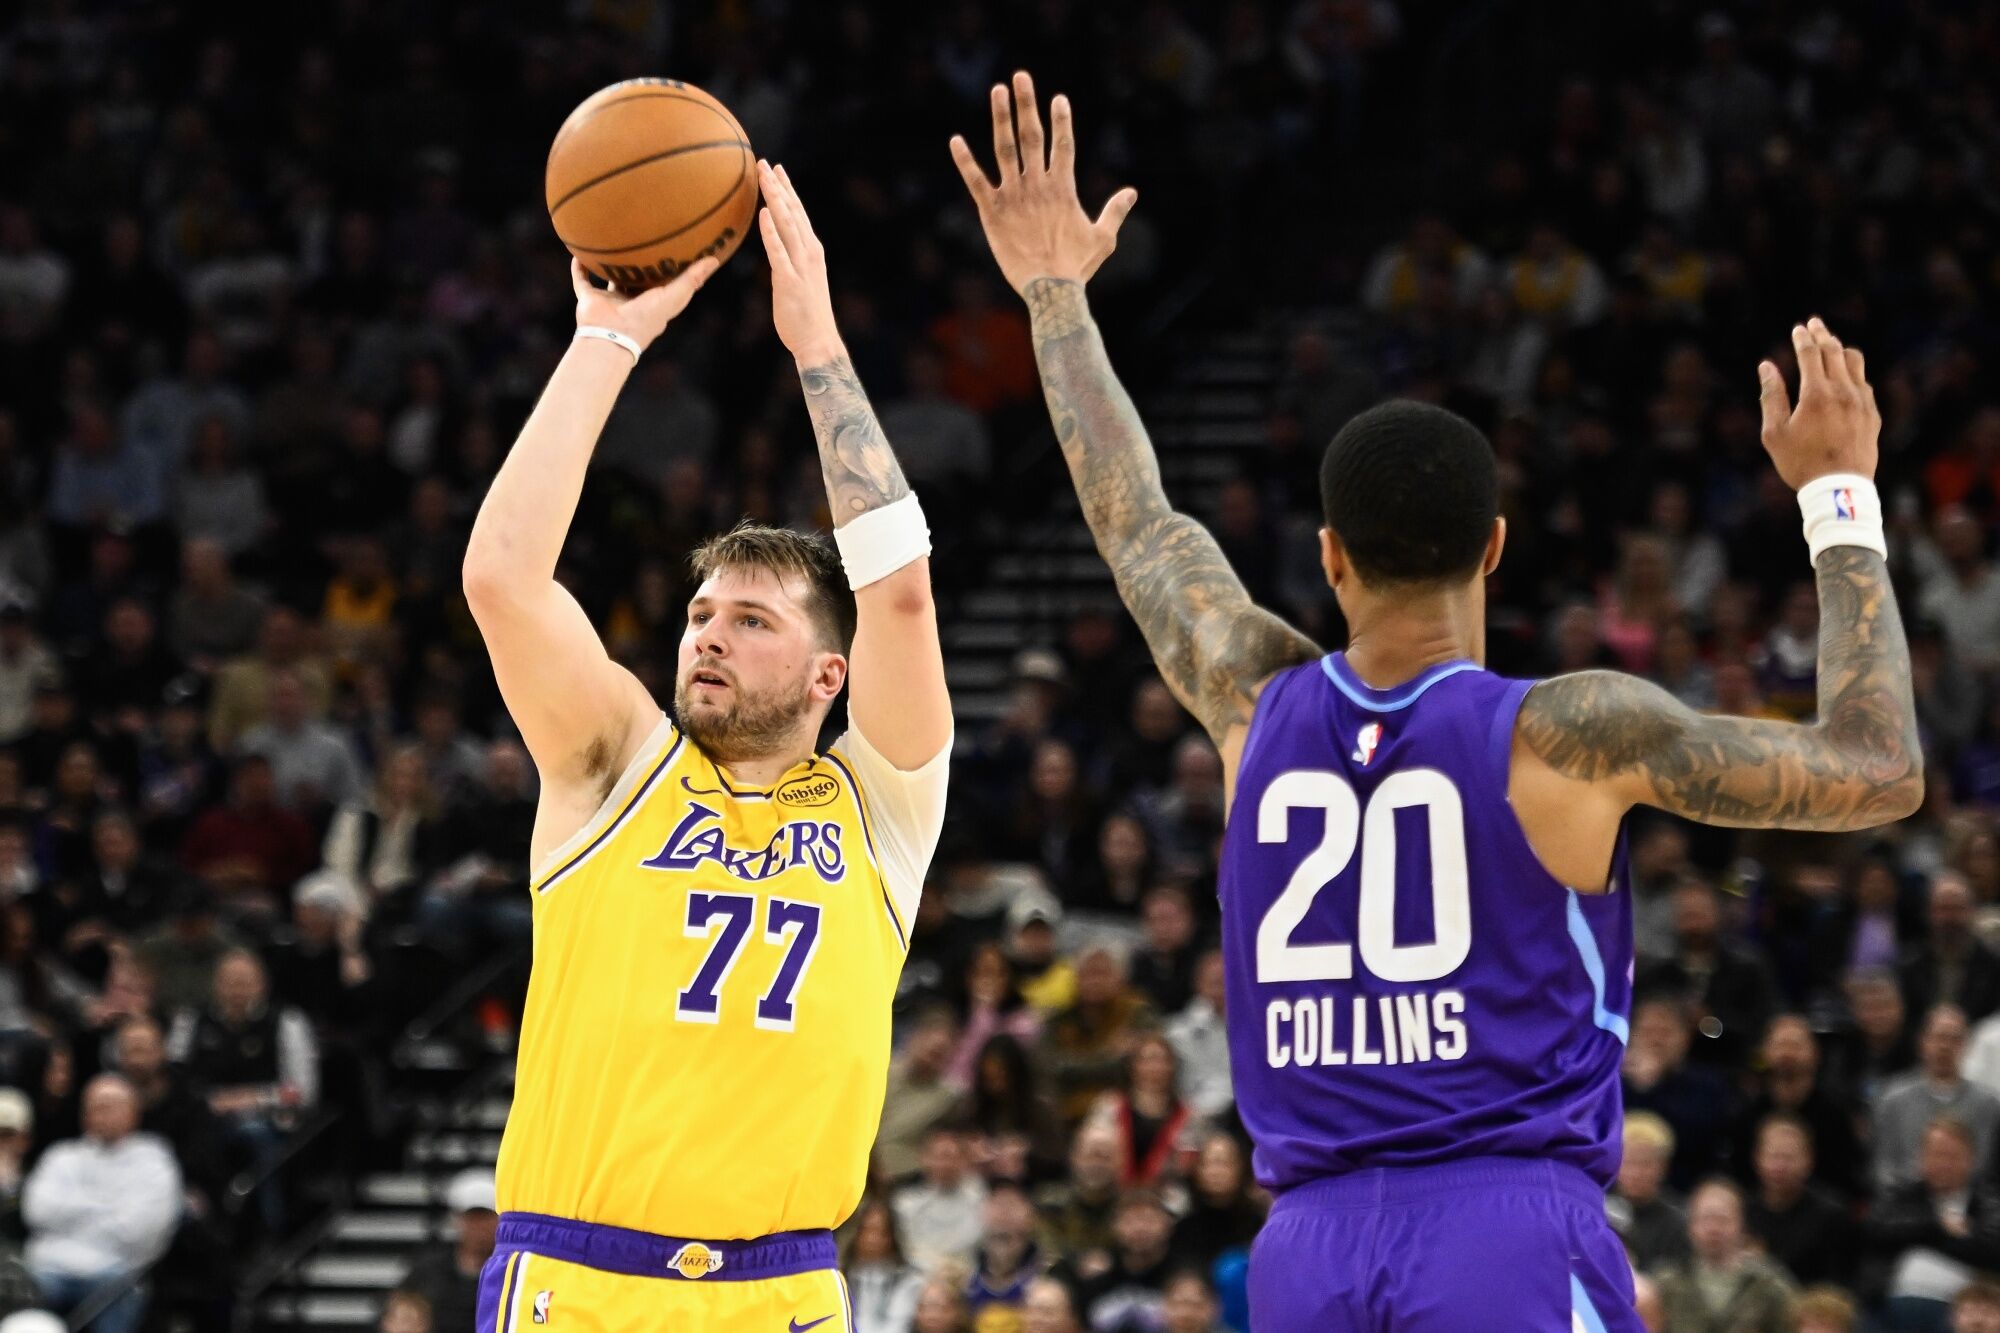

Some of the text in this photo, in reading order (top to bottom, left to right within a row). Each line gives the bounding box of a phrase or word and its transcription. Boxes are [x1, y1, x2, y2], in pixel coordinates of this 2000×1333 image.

[781, 781, 835, 801] bibigo
[640, 801, 846, 883] LAKERS
[1257, 769, 1471, 983] 20
[675, 889, 823, 1032] 77
[1266, 991, 1468, 1069] COLLINS
